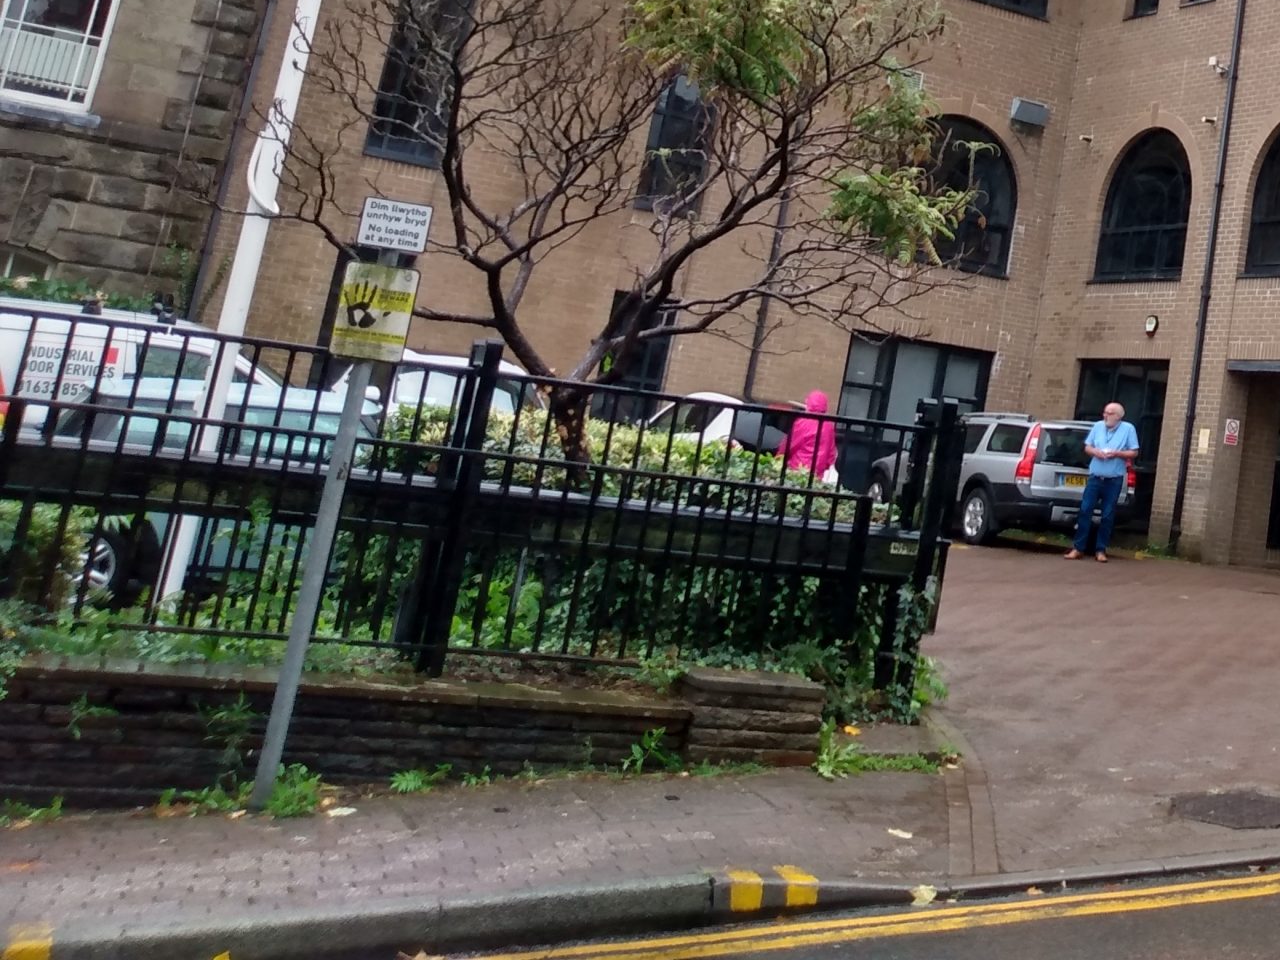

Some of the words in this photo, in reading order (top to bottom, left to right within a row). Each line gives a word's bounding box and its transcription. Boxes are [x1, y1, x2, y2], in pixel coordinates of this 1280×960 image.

[370, 201, 389, 211] Dim
[391, 204, 427, 217] llwytho
[366, 211, 402, 223] unrhyw
[404, 216, 426, 227] bryd
[368, 224, 382, 233] No
[384, 226, 419, 240] loading
[378, 236, 394, 246] any
[397, 238, 418, 248] time
[27, 345, 96, 363] NDUSRIAL
[58, 362, 116, 379] ERVICES
